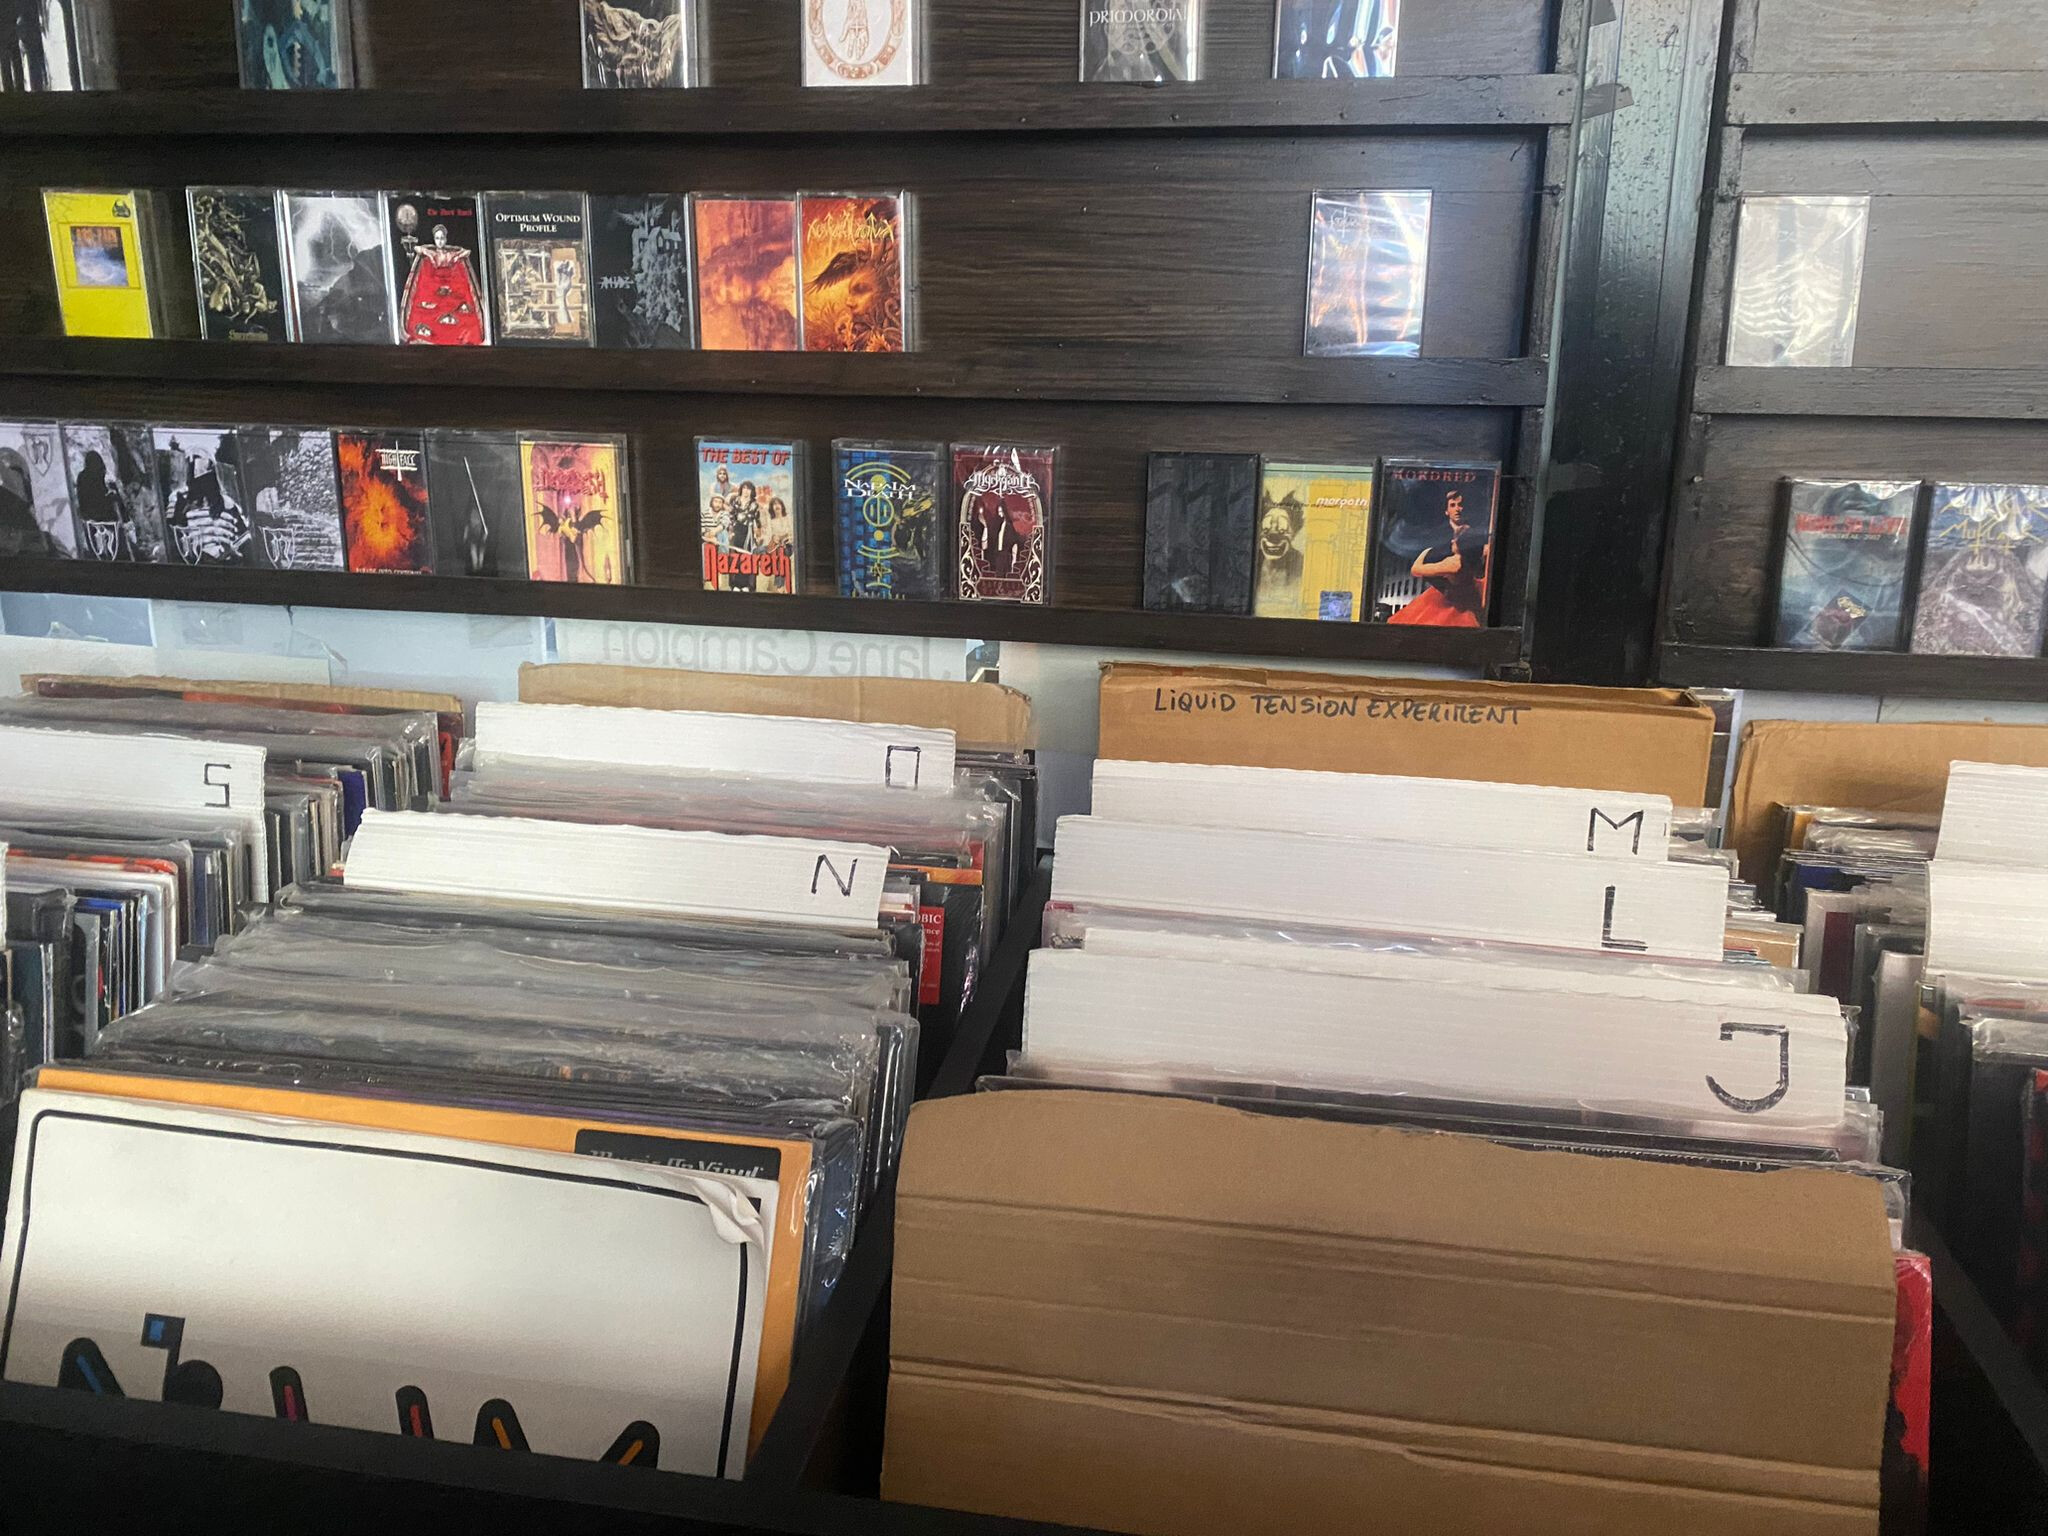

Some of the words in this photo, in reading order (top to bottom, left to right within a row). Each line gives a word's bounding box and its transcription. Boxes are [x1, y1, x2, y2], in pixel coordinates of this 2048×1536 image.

[495, 212, 540, 223] OPTIMUM
[542, 213, 580, 223] WOUND
[520, 223, 557, 233] PROFILE
[701, 447, 728, 464] THE
[731, 448, 768, 465] BEST
[772, 450, 790, 466] OF
[702, 541, 792, 593] Nazareth
[204, 762, 232, 808] S
[1587, 806, 1644, 855] M
[811, 853, 858, 897] N
[1601, 884, 1649, 951] L
[1705, 1021, 1790, 1114] J
